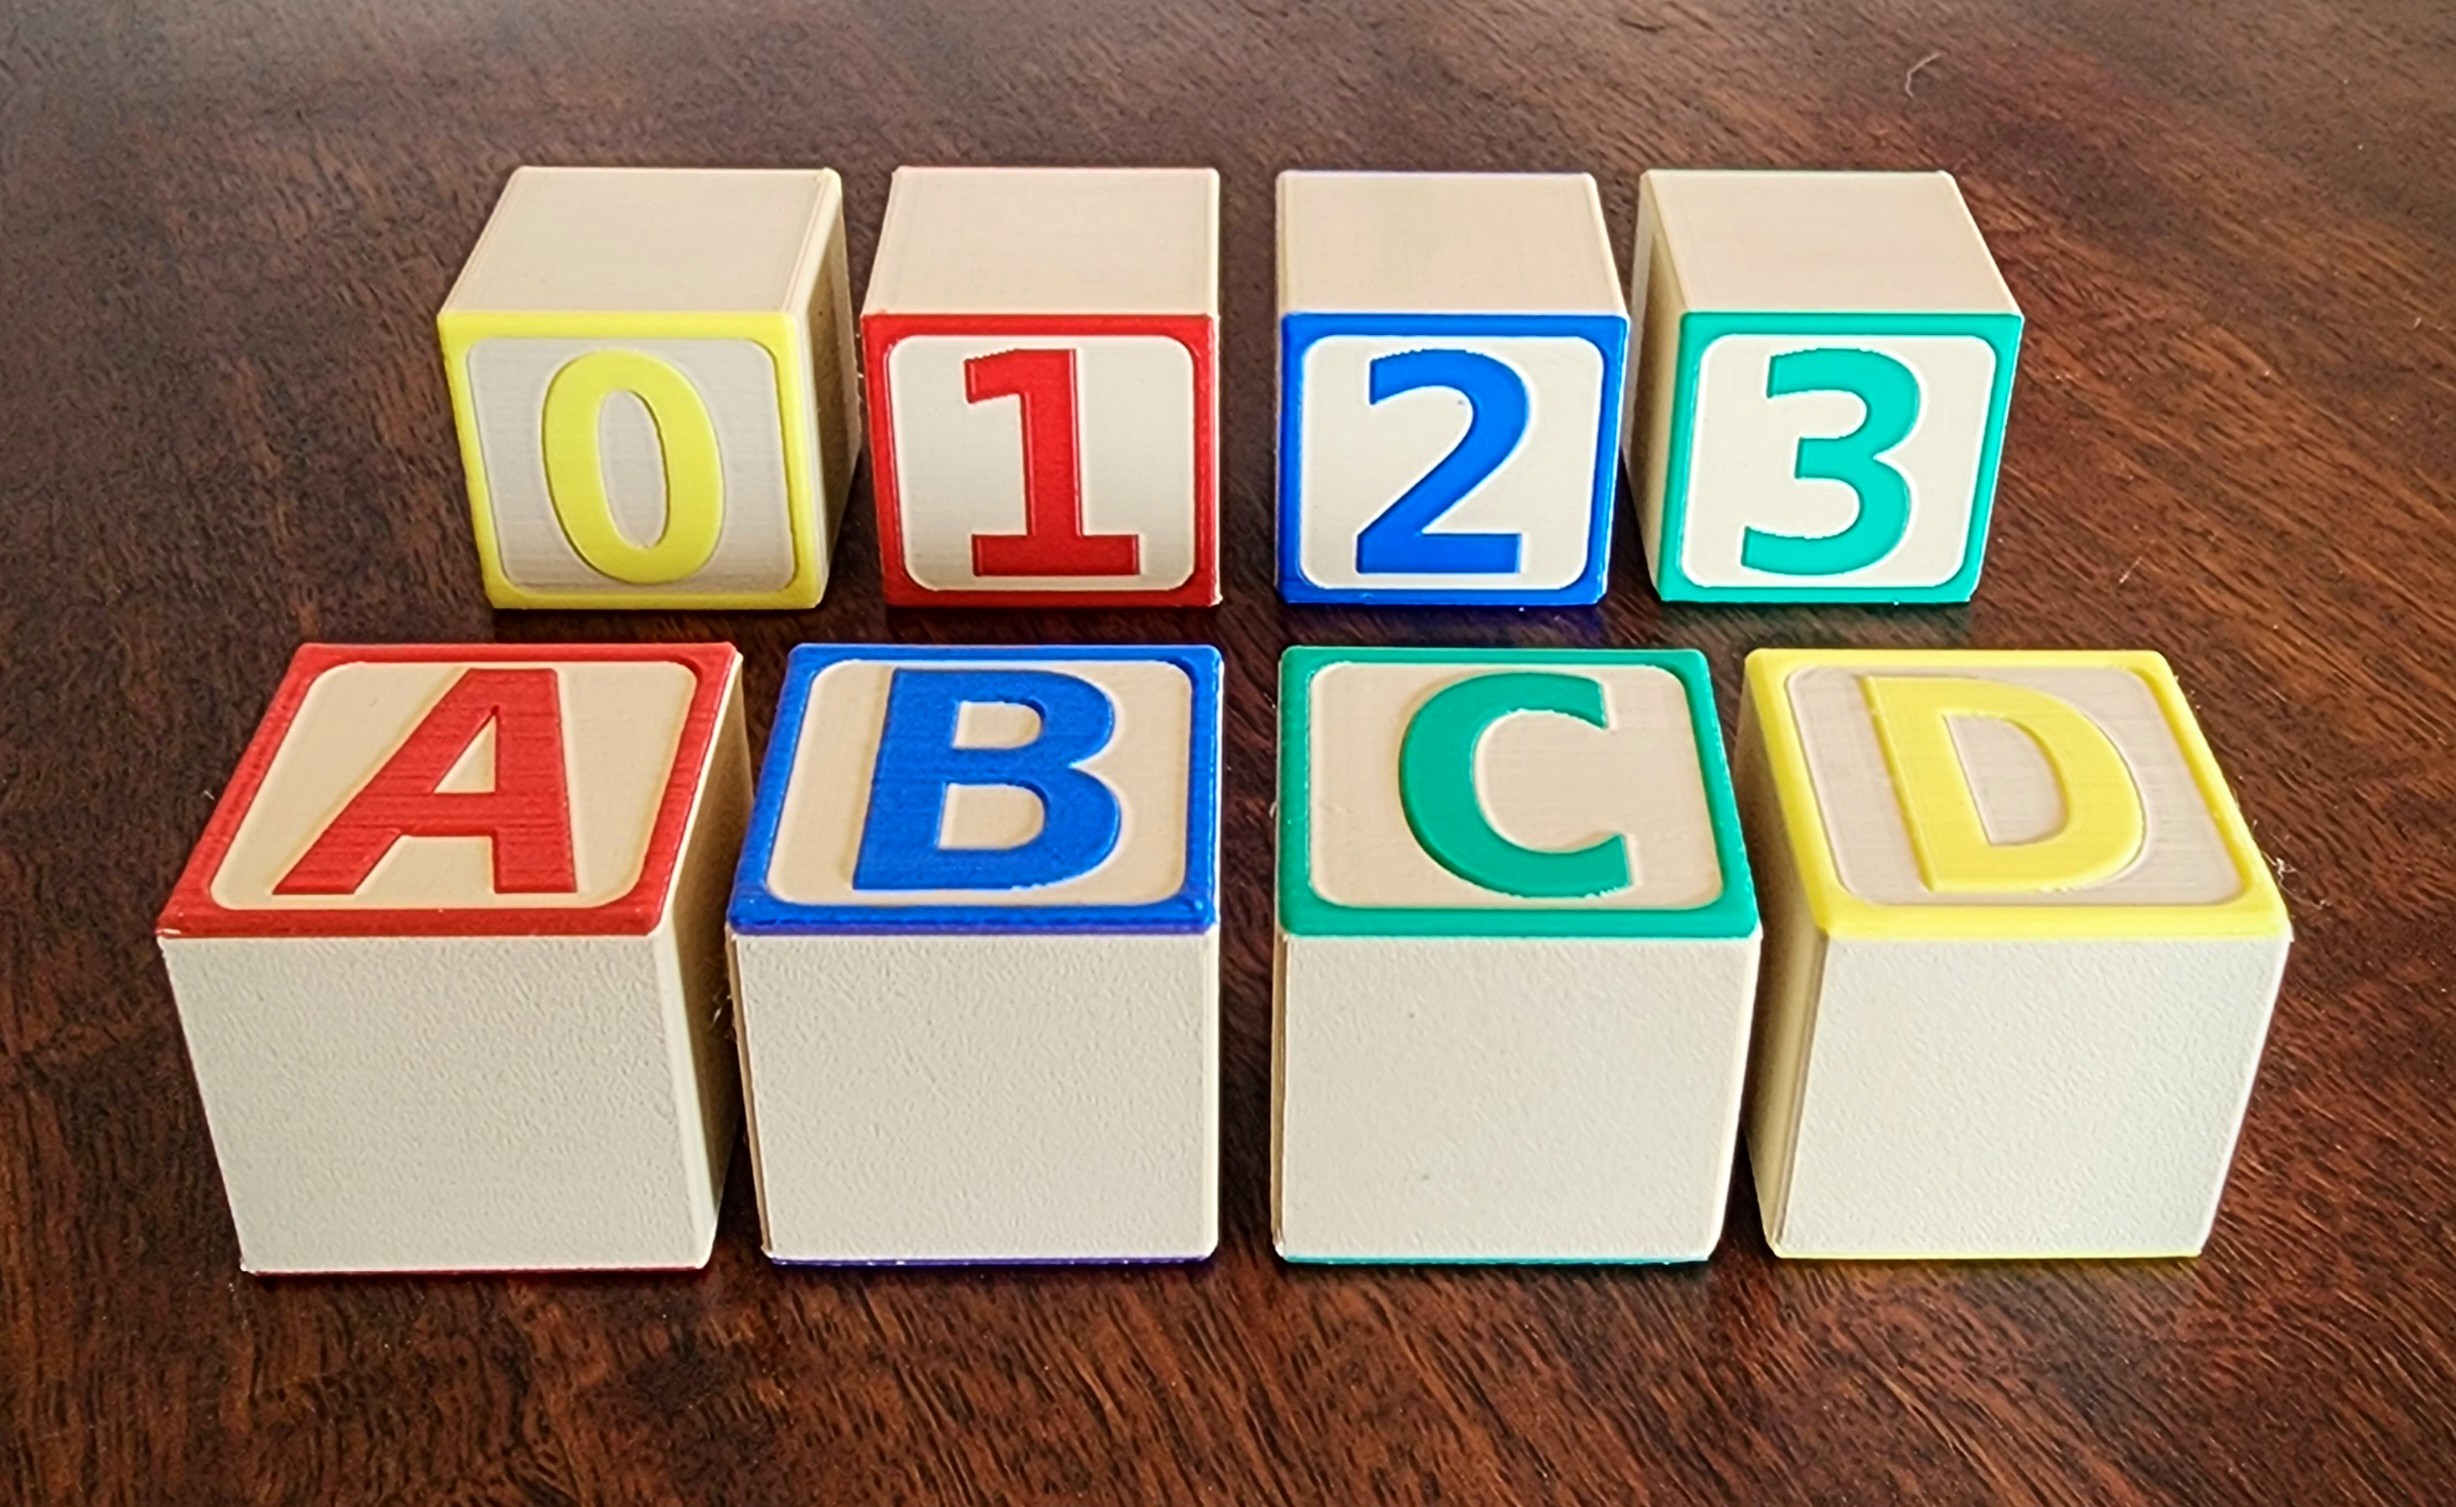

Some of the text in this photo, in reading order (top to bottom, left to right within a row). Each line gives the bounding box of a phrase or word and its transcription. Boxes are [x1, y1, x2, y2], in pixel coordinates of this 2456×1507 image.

[540, 350, 726, 583] 0
[965, 349, 1140, 577] 1
[1356, 349, 1530, 576] 2
[1741, 348, 1920, 576] 3
[271, 667, 578, 895] A
[853, 669, 1122, 892] B
[1398, 671, 1631, 899] C
[1857, 676, 2144, 893] D
